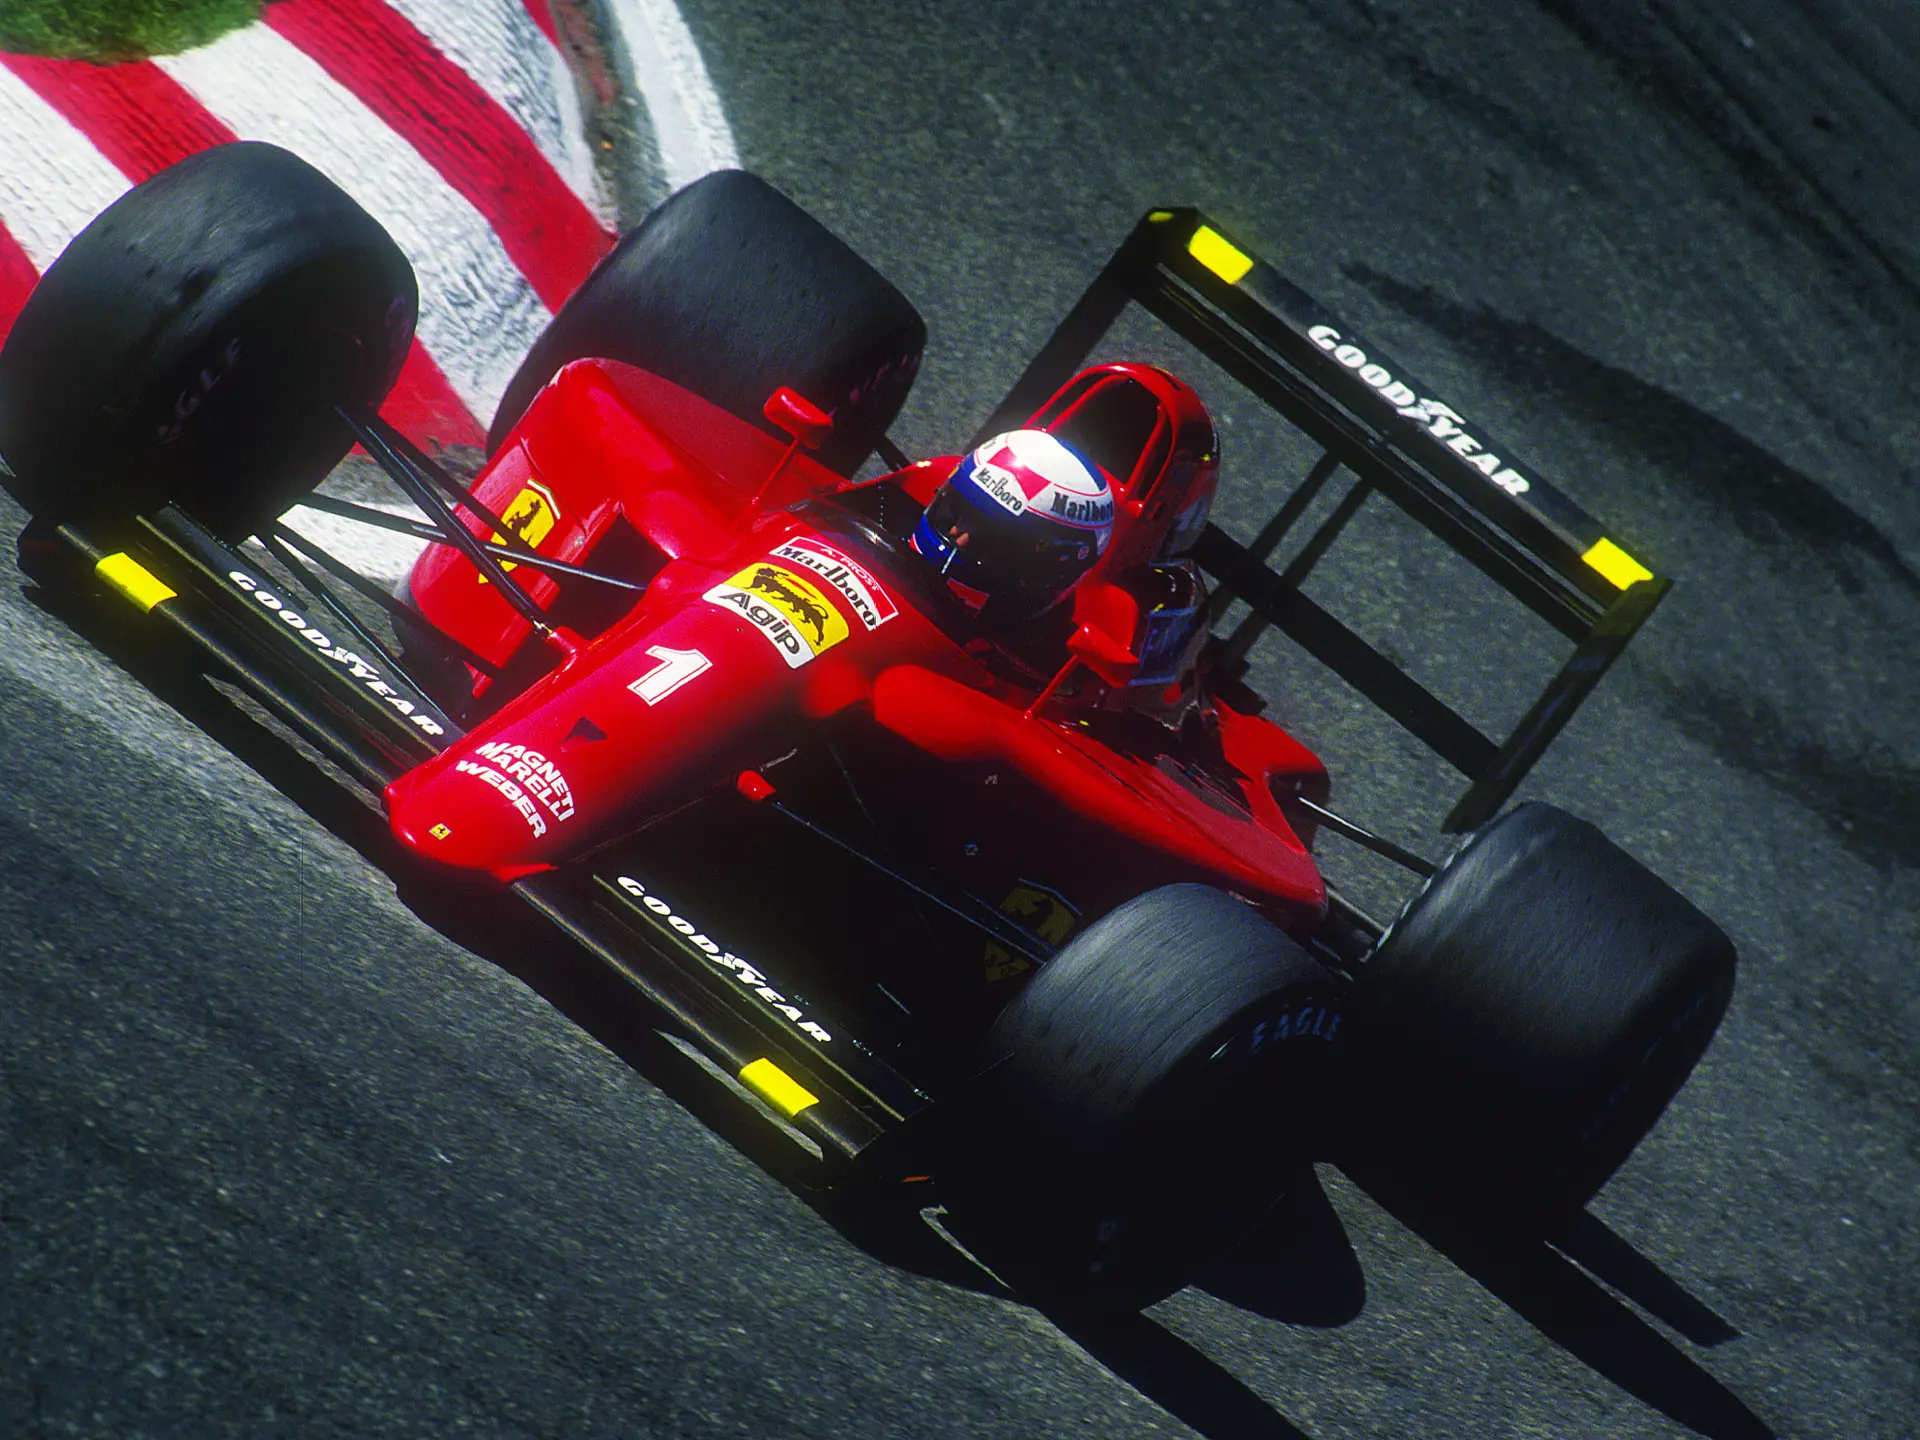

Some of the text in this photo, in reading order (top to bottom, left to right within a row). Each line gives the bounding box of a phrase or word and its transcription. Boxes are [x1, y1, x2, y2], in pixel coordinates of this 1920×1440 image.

[1308, 325, 1530, 496] GOODYEAR
[975, 467, 1024, 512] Marlboro
[718, 591, 801, 655] Agip
[778, 546, 878, 627] Marlboro
[229, 571, 444, 736] GOODYEAR
[627, 645, 713, 707] 1
[455, 760, 547, 839] WEBER
[475, 741, 575, 822] MAGNETI
[475, 741, 575, 822] MARELLI
[617, 876, 832, 1042] GOODYEAR
